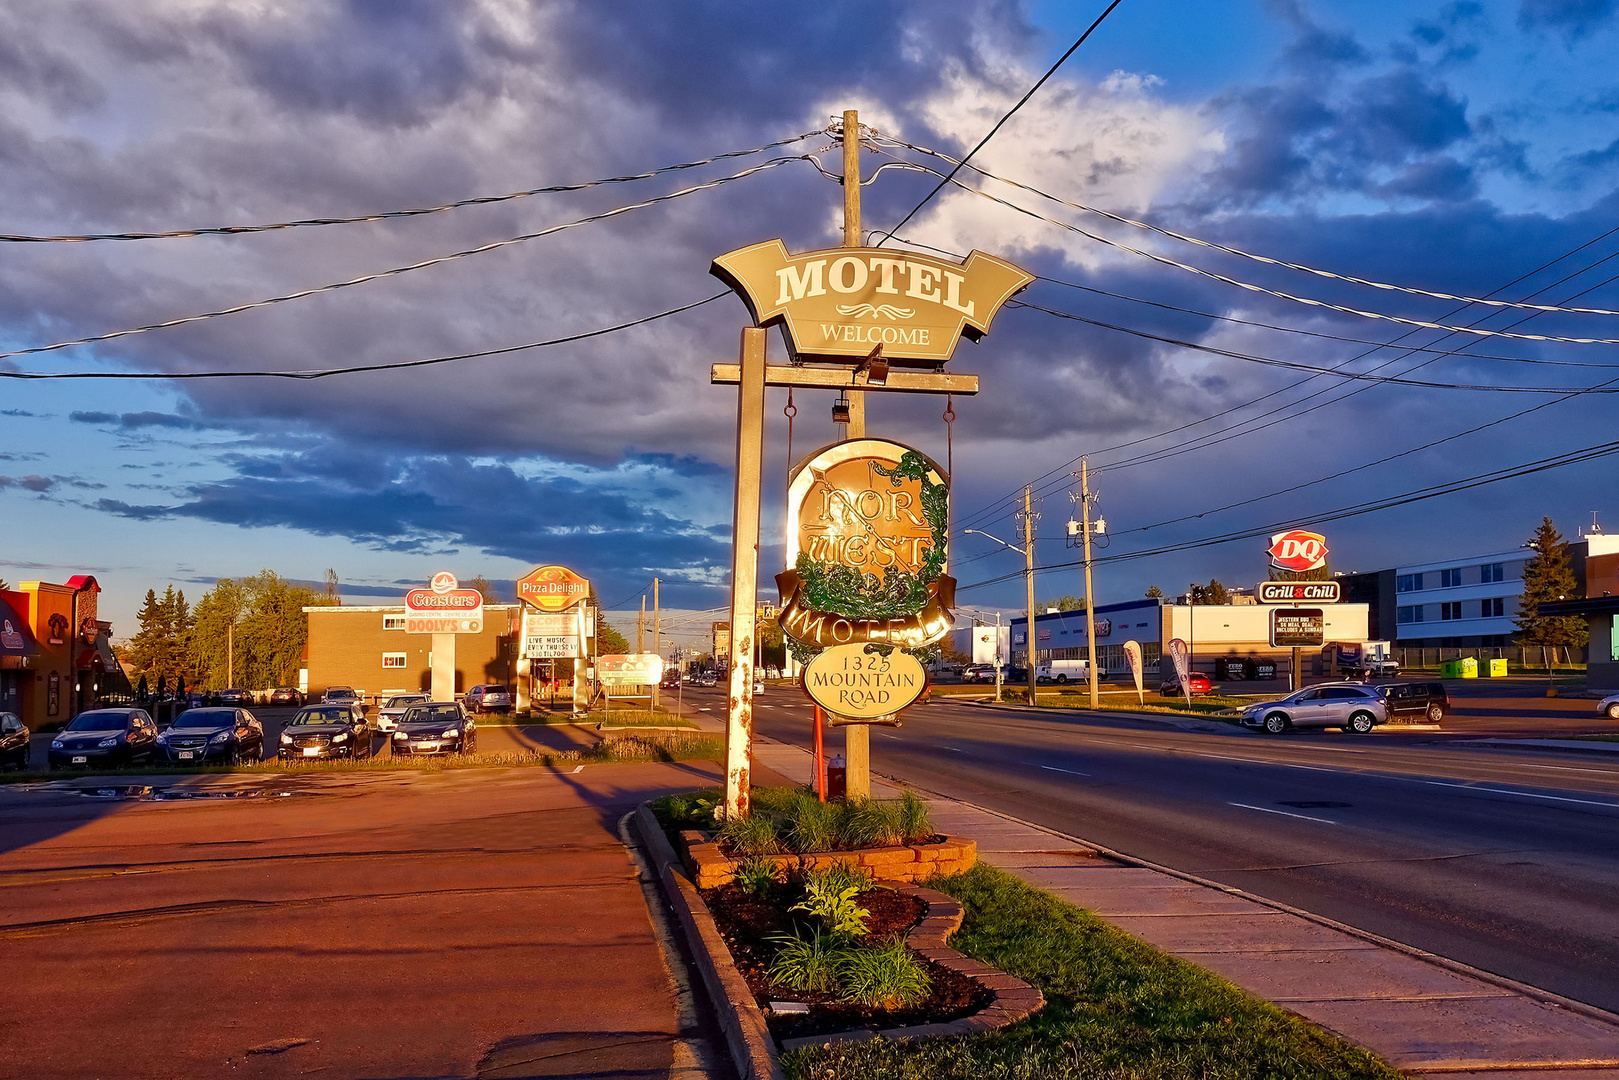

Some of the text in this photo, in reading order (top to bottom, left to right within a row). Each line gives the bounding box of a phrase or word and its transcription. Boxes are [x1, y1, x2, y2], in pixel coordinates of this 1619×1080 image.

[775, 256, 975, 318] MOTEL
[821, 324, 931, 346] WELCOME
[818, 488, 928, 526] NOR
[807, 534, 932, 567] WEST
[1278, 539, 1320, 562] DQ
[522, 582, 584, 596] Pizza Delight
[412, 593, 475, 607] Coasters
[408, 619, 458, 632] DOOLY'S
[790, 611, 944, 644] MOTEL
[842, 655, 892, 672] 1325
[812, 672, 916, 688] MOUNTAIN
[839, 689, 891, 709] ROAD
